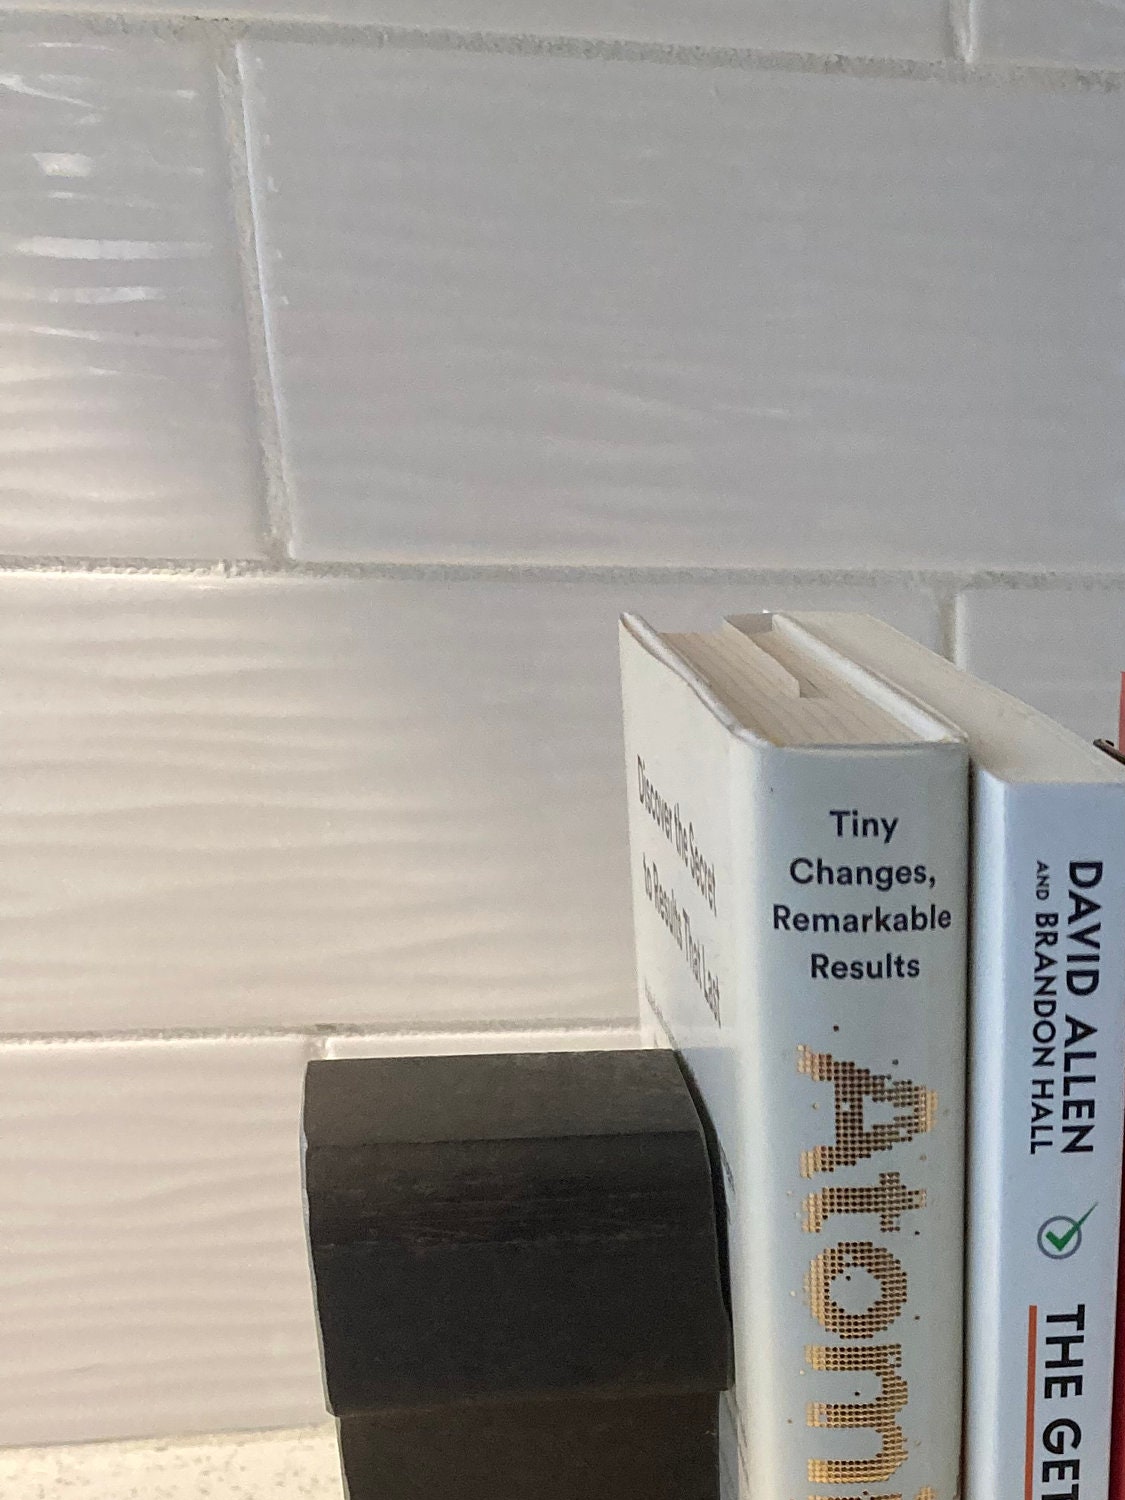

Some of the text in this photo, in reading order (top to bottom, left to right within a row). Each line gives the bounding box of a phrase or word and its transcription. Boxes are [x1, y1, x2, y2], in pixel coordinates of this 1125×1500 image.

[637, 754, 717, 917] Discover the Secret
[829, 810, 899, 843] Tiny
[643, 852, 652, 901] to
[789, 857, 936, 891] Changes,
[773, 904, 952, 934] Remarkable
[810, 953, 921, 980] Results
[1029, 860, 1058, 1156] AND BRANDON HALL
[1061, 860, 1104, 1155] DAVID ALLEN
[1043, 1303, 1086, 1399] THE
